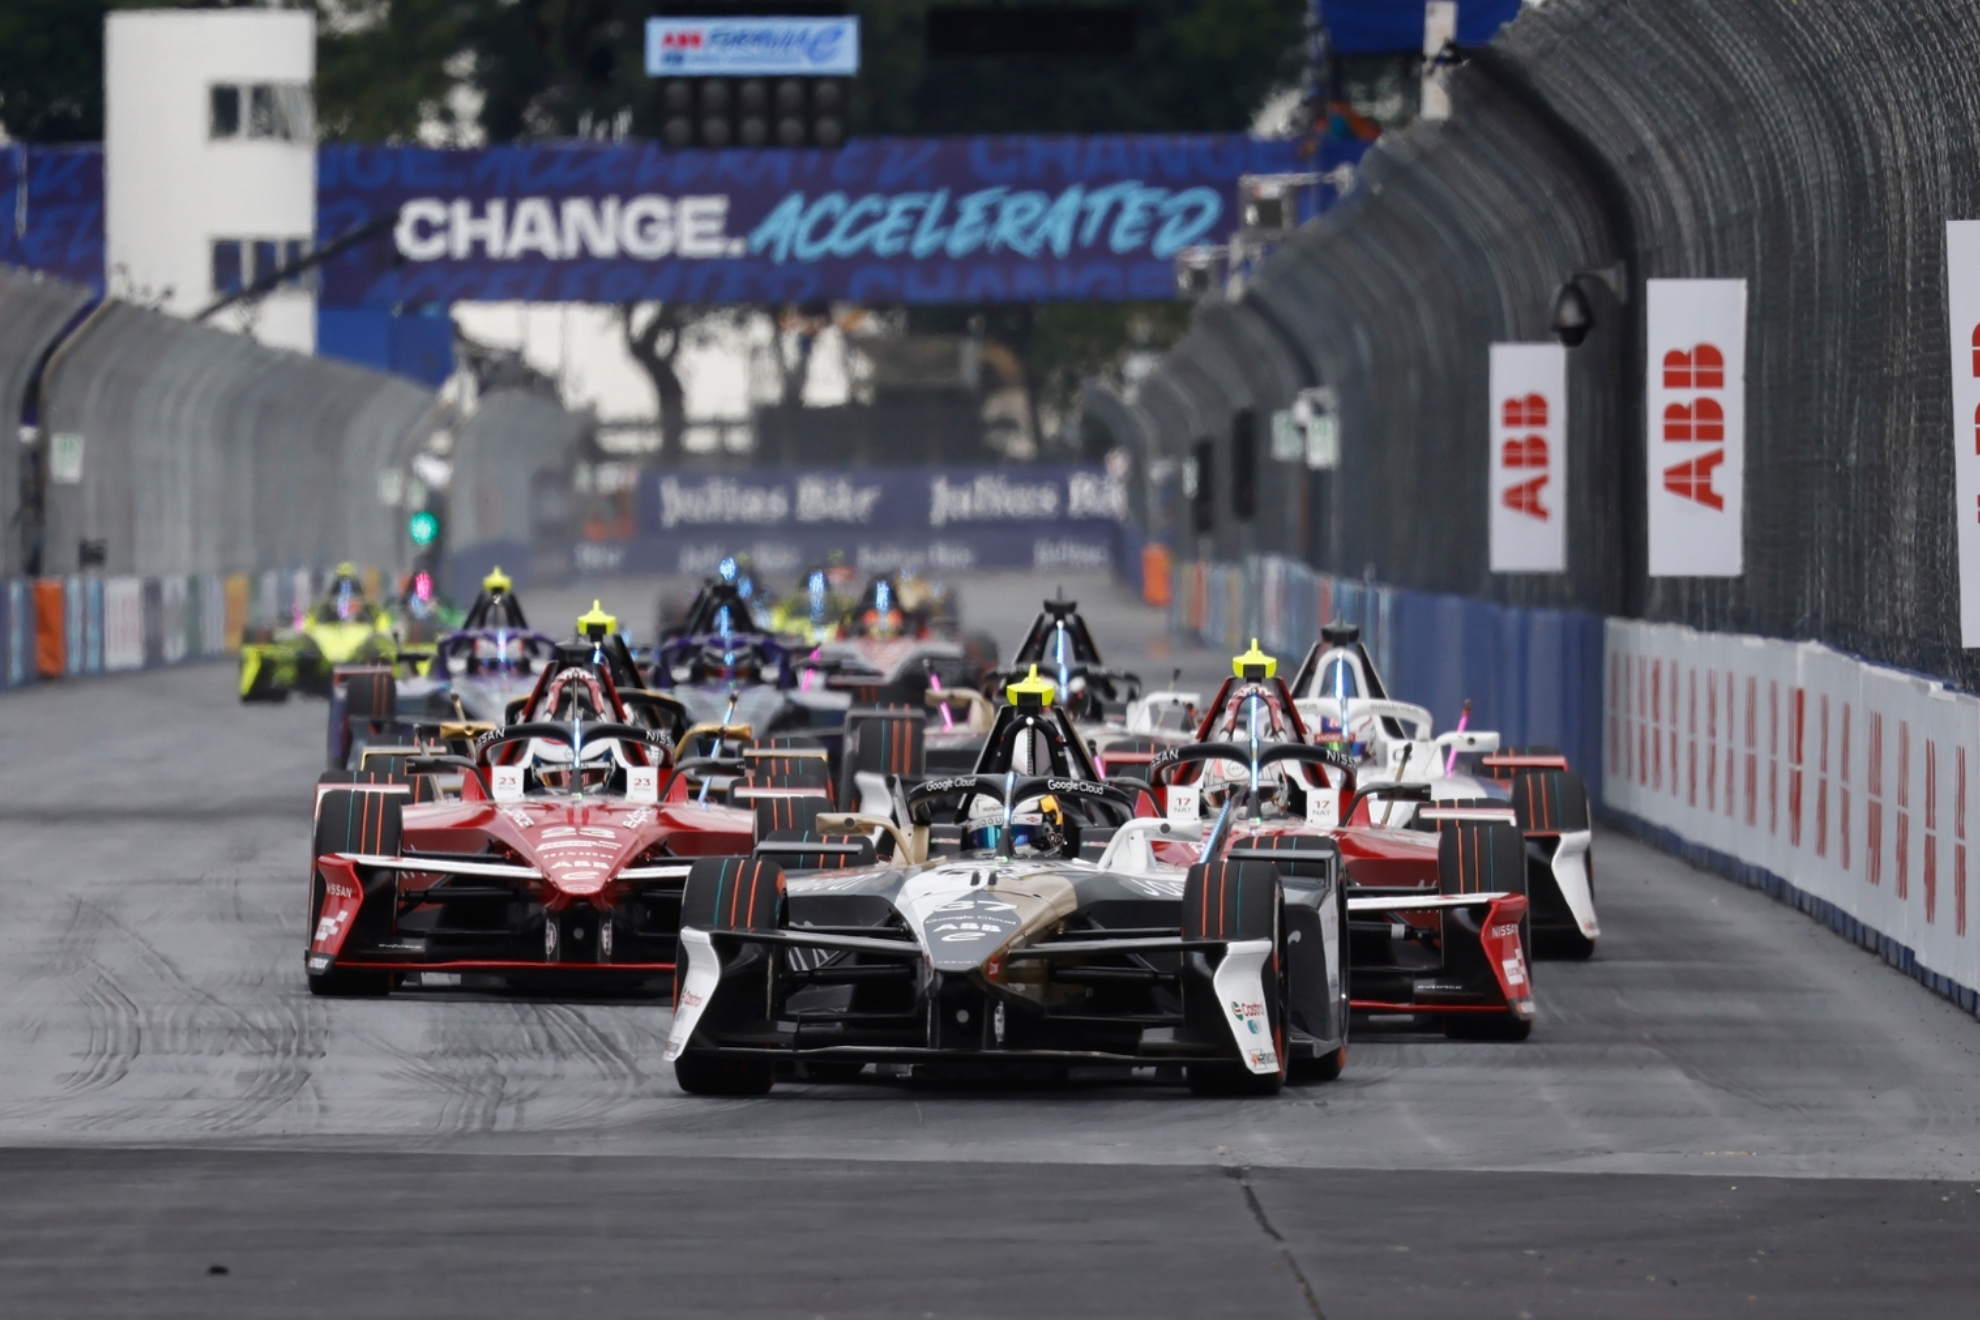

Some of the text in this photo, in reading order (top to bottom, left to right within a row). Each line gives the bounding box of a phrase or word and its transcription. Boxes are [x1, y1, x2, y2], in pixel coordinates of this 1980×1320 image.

[393, 194, 747, 262] CHANGE.
[747, 180, 1222, 264] ACCELERATED
[1664, 343, 1725, 514] ABB
[1502, 393, 1551, 524] ABB
[499, 776, 517, 786] 23
[634, 777, 651, 787] 23
[926, 777, 977, 792] Google Cloud
[1047, 779, 1104, 796] Google Cloud
[1176, 797, 1192, 806] 17
[1314, 800, 1331, 809] 17
[541, 826, 616, 840] 23
[932, 922, 1002, 933] ABB
